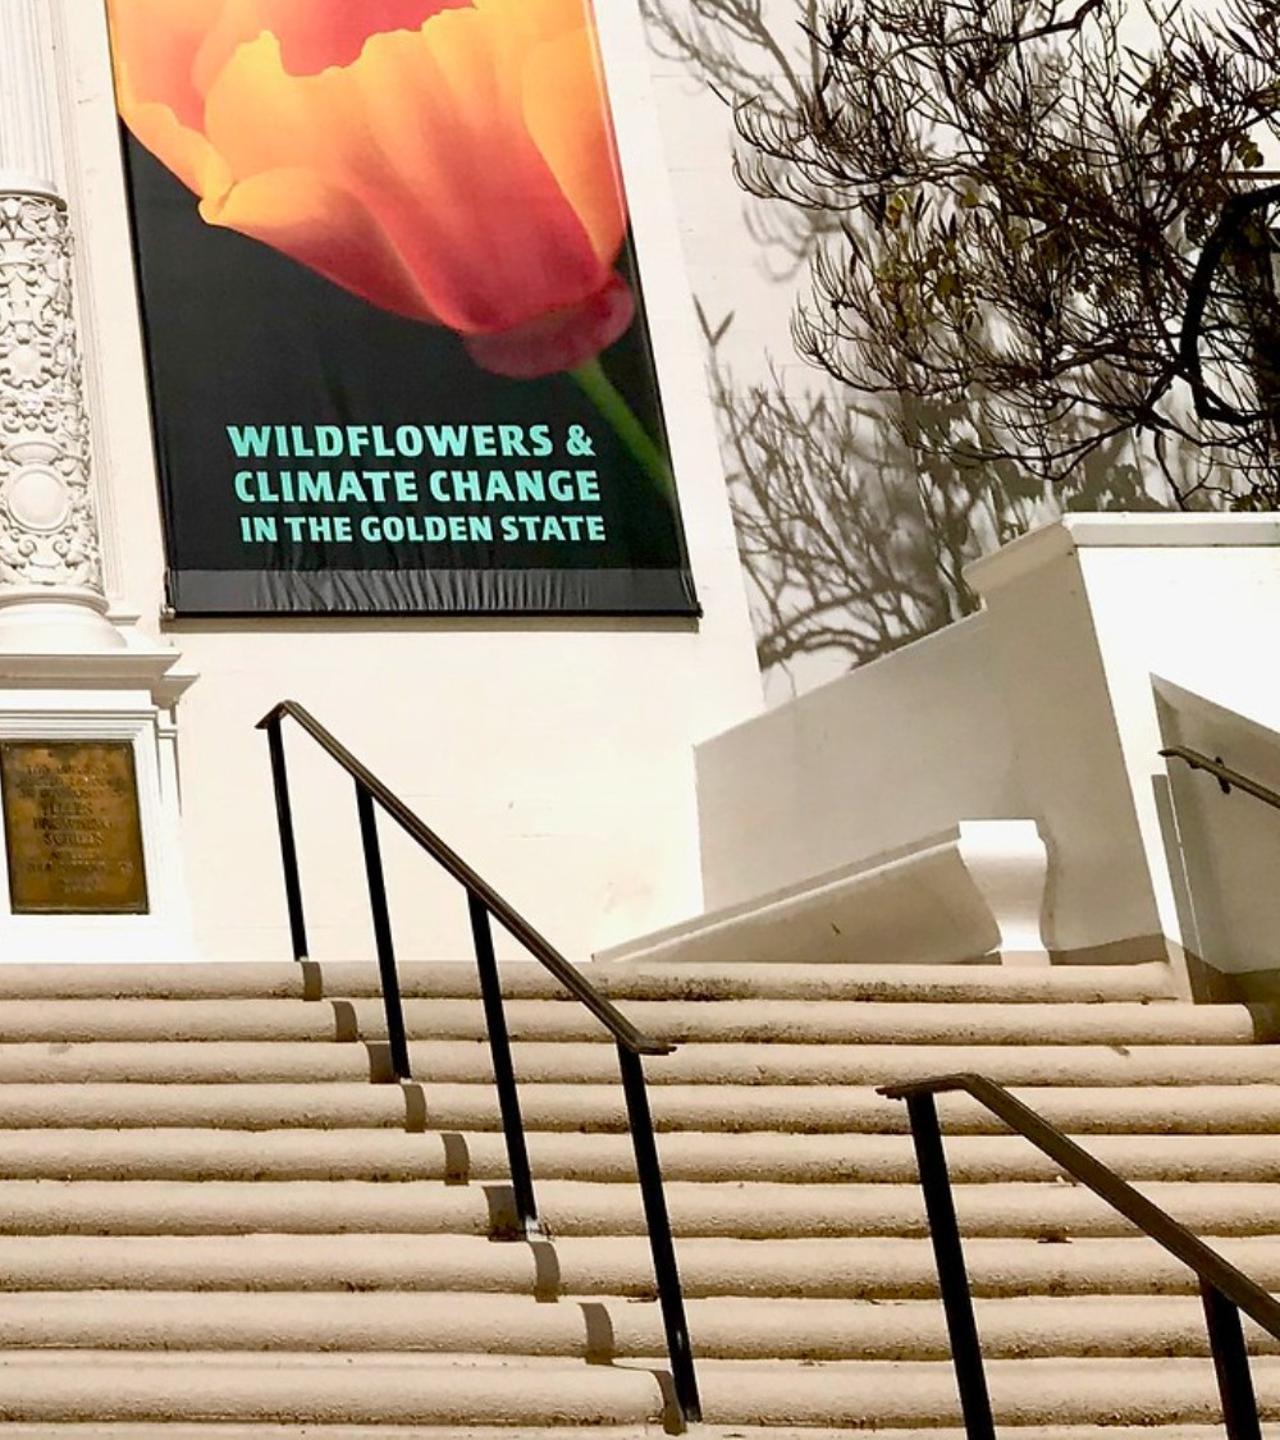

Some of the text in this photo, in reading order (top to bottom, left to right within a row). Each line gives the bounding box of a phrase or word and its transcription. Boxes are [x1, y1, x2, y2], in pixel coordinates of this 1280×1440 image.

[226, 424, 596, 457] WILDFLOWERS &
[234, 470, 601, 503] CLIMATE CHANGE
[240, 515, 607, 543] IN THE GOLDEN STATE
